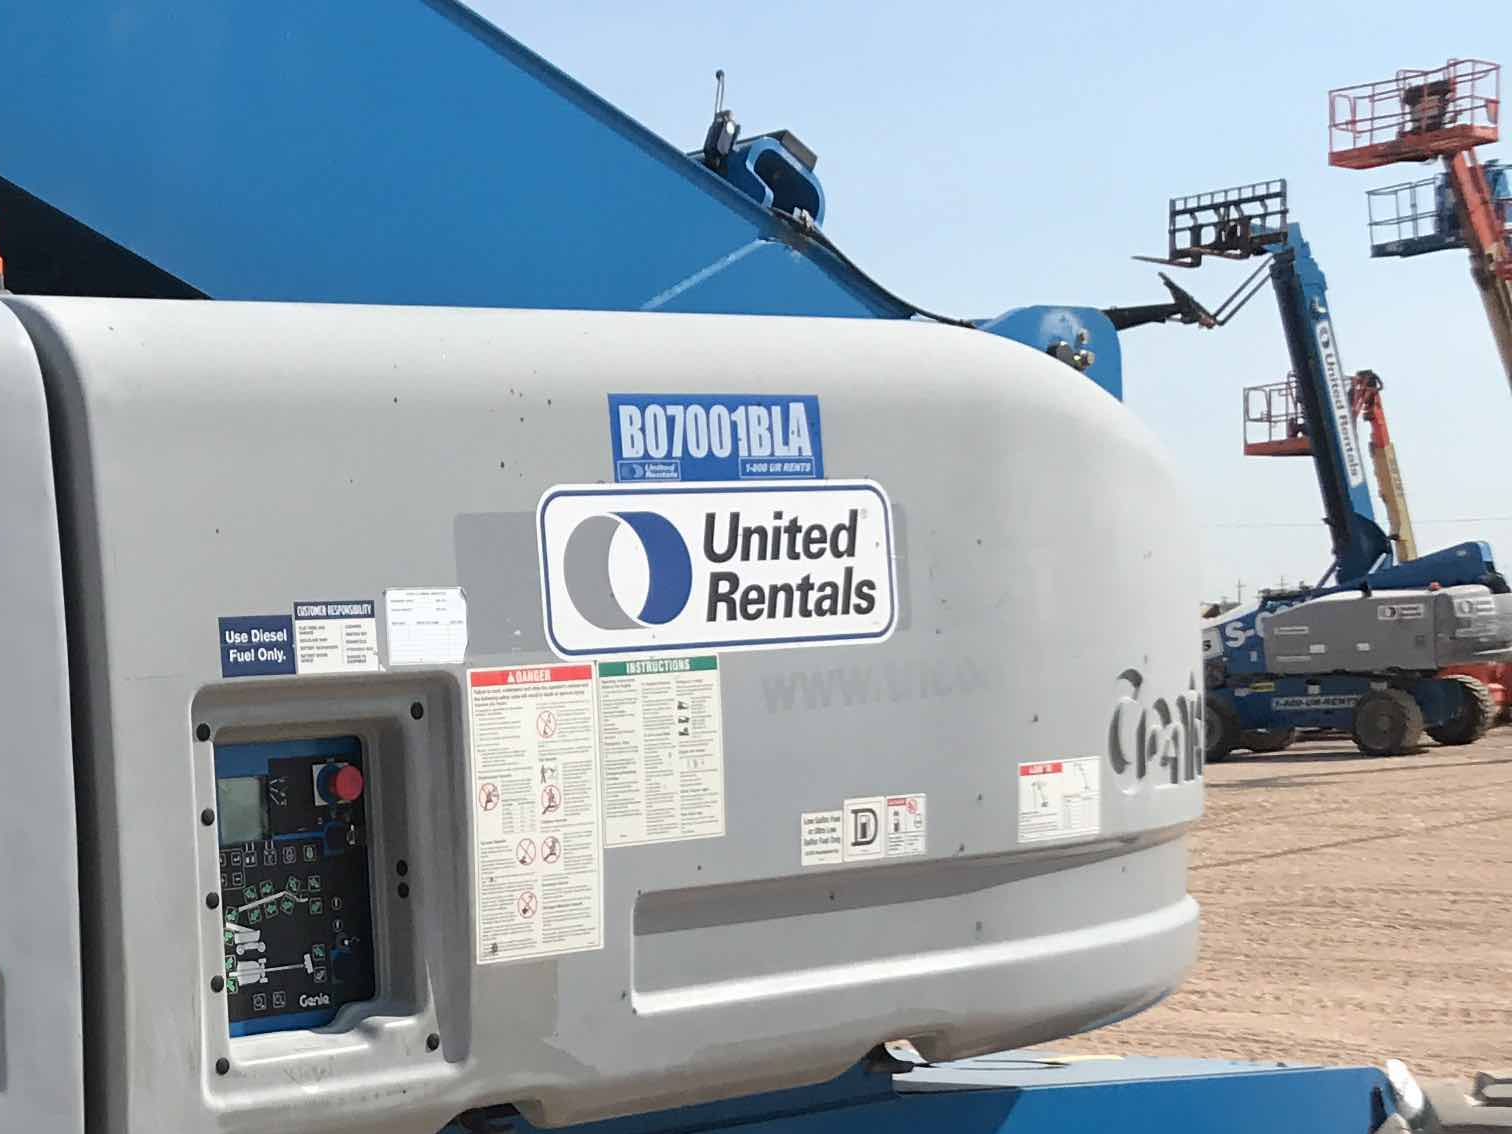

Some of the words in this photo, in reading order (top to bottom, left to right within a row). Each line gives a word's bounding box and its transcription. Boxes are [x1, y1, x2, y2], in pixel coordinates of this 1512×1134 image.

[1324, 351, 1346, 411] United
[1338, 414, 1360, 477] Rentals
[702, 509, 859, 563] United
[705, 566, 877, 622] Rentals
[225, 630, 248, 644] Use
[251, 628, 288, 643] Diesel
[229, 648, 255, 662] Fuel
[257, 649, 287, 664] Only.
[626, 659, 691, 675] INSTRUCTIONS
[516, 669, 552, 684] DANGER
[850, 807, 879, 847] D
[299, 993, 330, 1008] Genie
